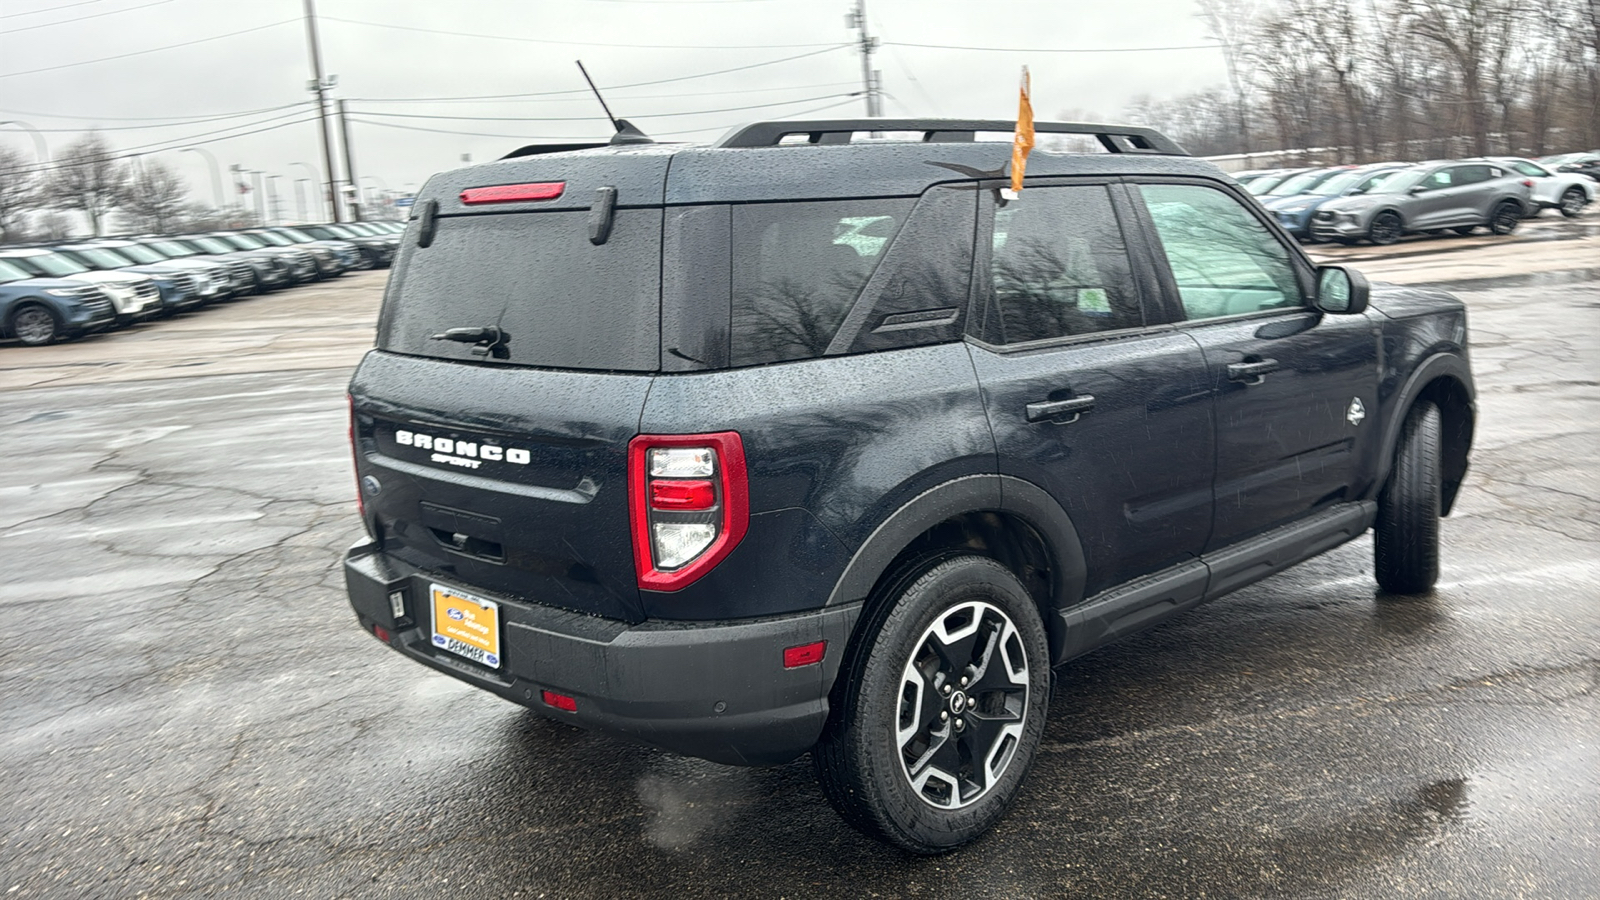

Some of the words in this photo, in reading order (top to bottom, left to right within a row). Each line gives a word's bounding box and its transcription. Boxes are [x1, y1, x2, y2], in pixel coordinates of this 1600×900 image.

[395, 429, 531, 465] BRONCO
[430, 452, 483, 469] SPORT
[447, 638, 485, 662] DEMMER
